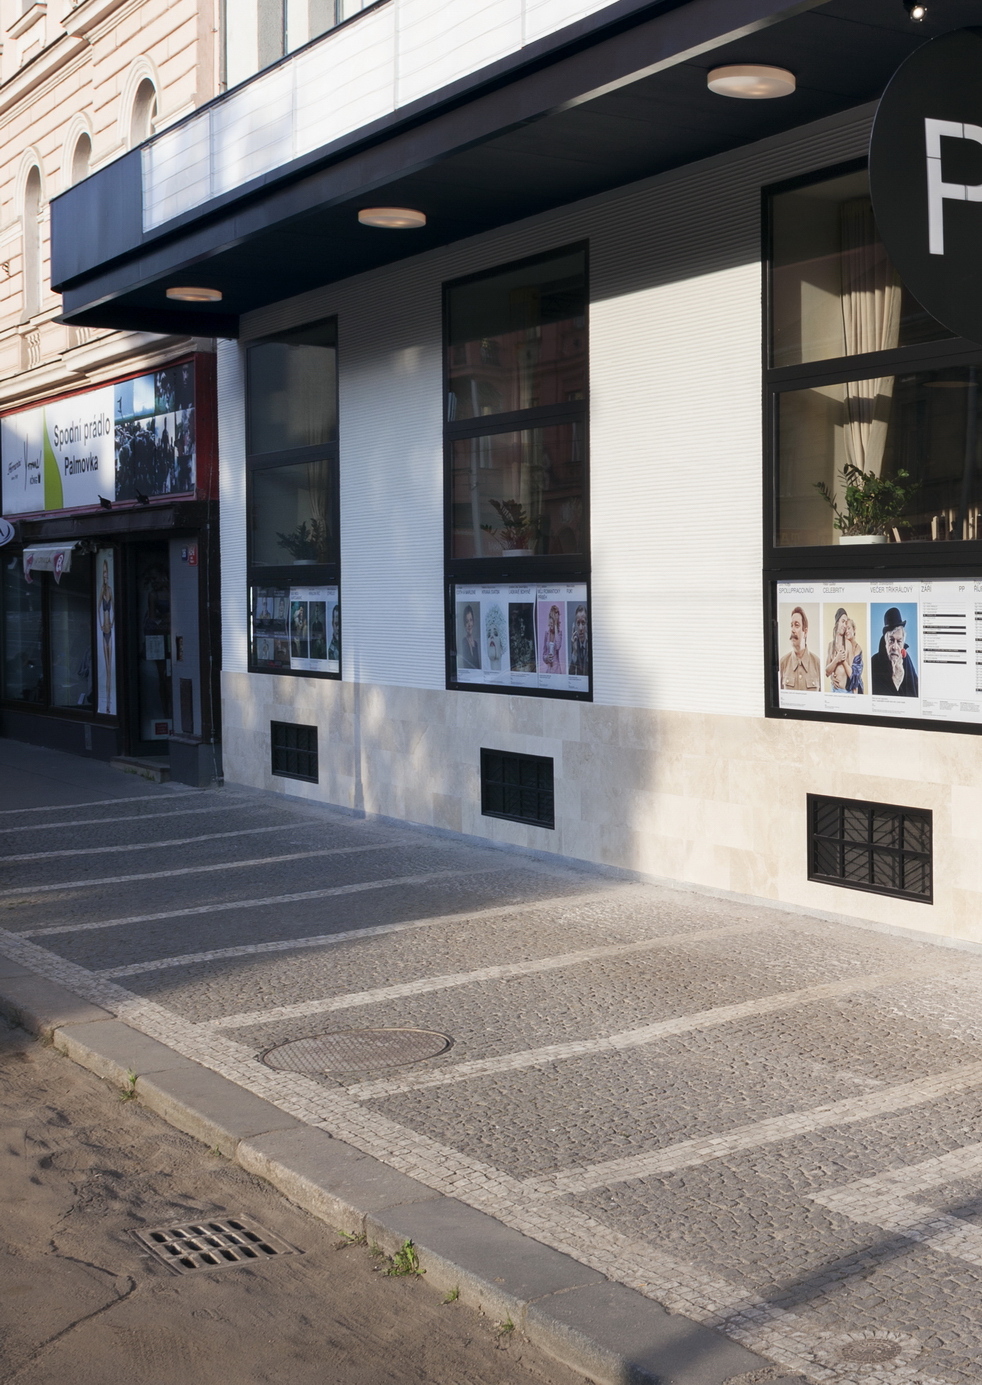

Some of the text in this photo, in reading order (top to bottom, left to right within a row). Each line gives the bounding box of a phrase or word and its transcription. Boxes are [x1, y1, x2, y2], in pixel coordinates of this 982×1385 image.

[54, 412, 111, 452] Spodní prádlo
[64, 452, 99, 476] Palmovka
